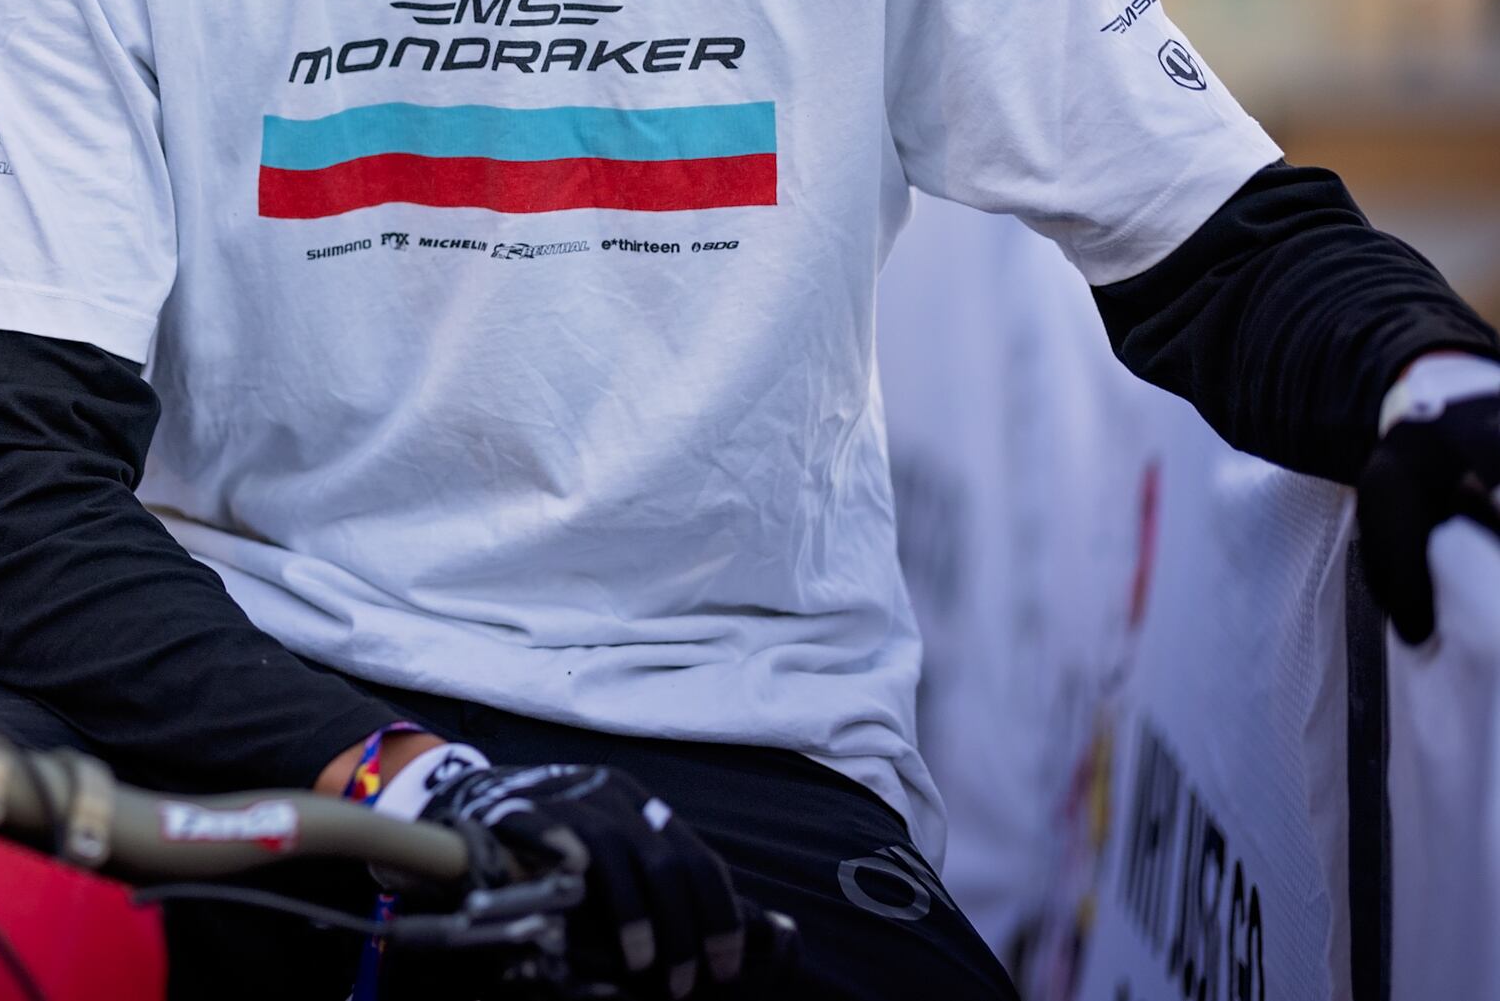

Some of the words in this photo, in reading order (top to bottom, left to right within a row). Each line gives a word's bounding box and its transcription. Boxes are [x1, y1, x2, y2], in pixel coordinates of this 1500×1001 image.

[289, 36, 746, 85] MONDRAKER
[306, 238, 372, 261] SHIMANO
[380, 232, 410, 249] FOX
[418, 237, 488, 252] MICHELIN
[702, 240, 740, 251] SDG
